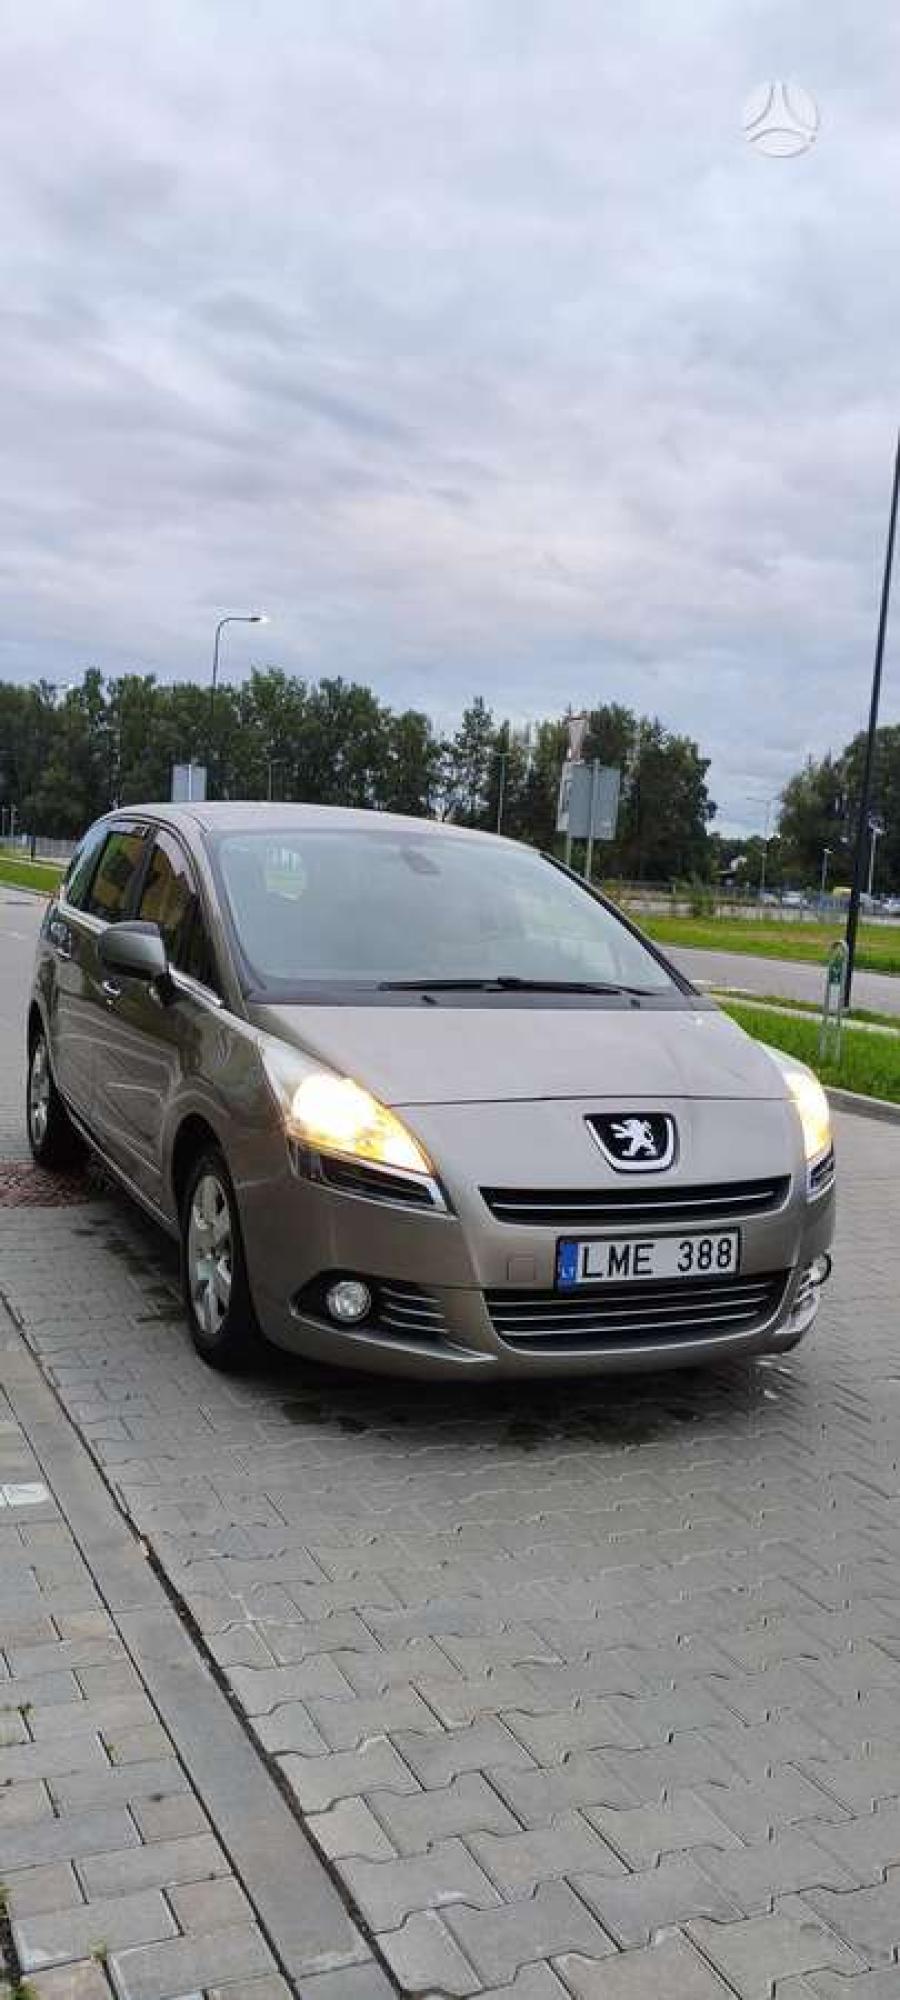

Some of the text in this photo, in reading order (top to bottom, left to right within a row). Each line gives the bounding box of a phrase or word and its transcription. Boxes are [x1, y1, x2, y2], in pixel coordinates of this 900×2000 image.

[582, 1237, 732, 1279] LME 388
[561, 1266, 575, 1280] LT
